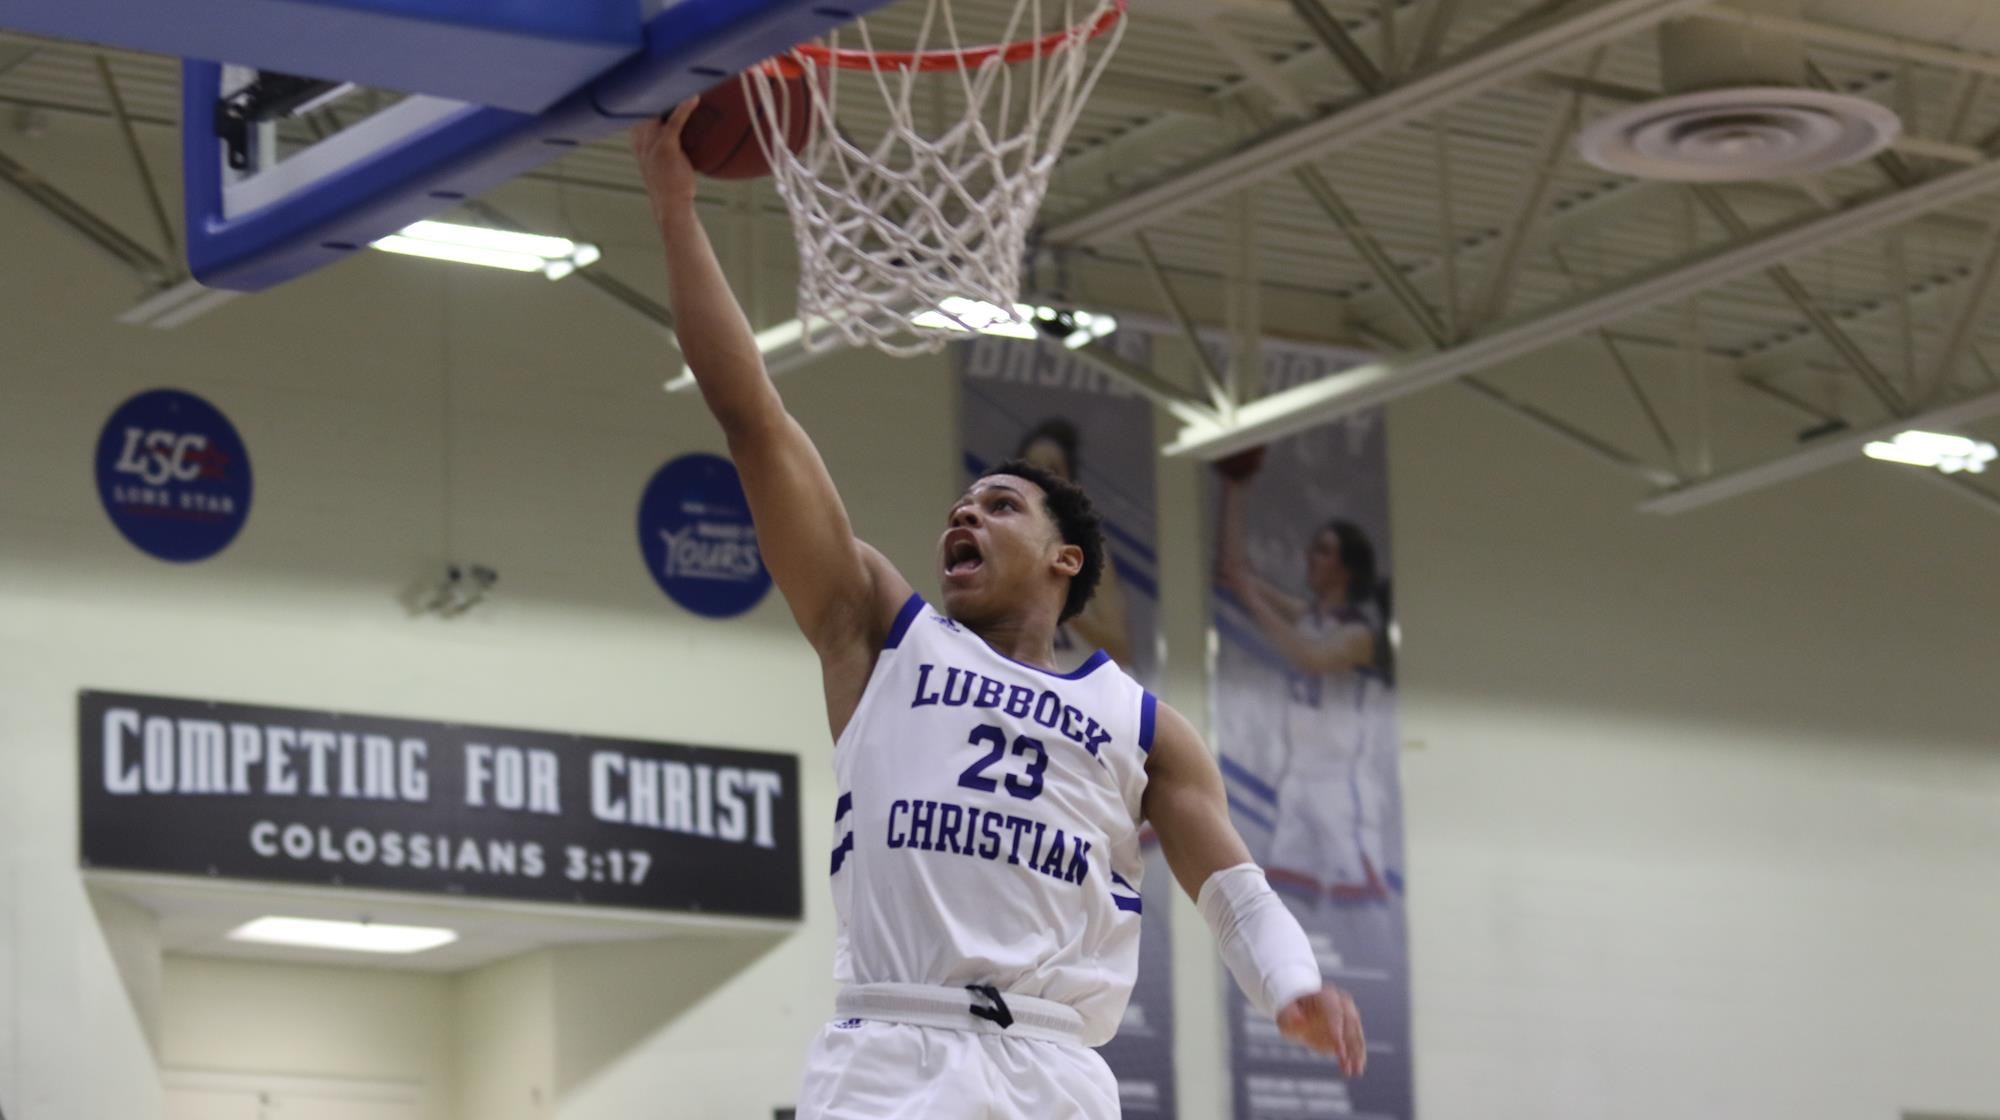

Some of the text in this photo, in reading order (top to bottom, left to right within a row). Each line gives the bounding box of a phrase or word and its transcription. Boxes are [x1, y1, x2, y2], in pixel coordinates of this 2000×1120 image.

[115, 426, 206, 485] LSC
[911, 663, 1113, 769] LUBBOCK
[464, 743, 561, 815] FOR
[957, 723, 1049, 800] 23
[250, 820, 651, 885] COLOSSIANS 3:17
[887, 798, 1093, 886] CHRISTIAN
